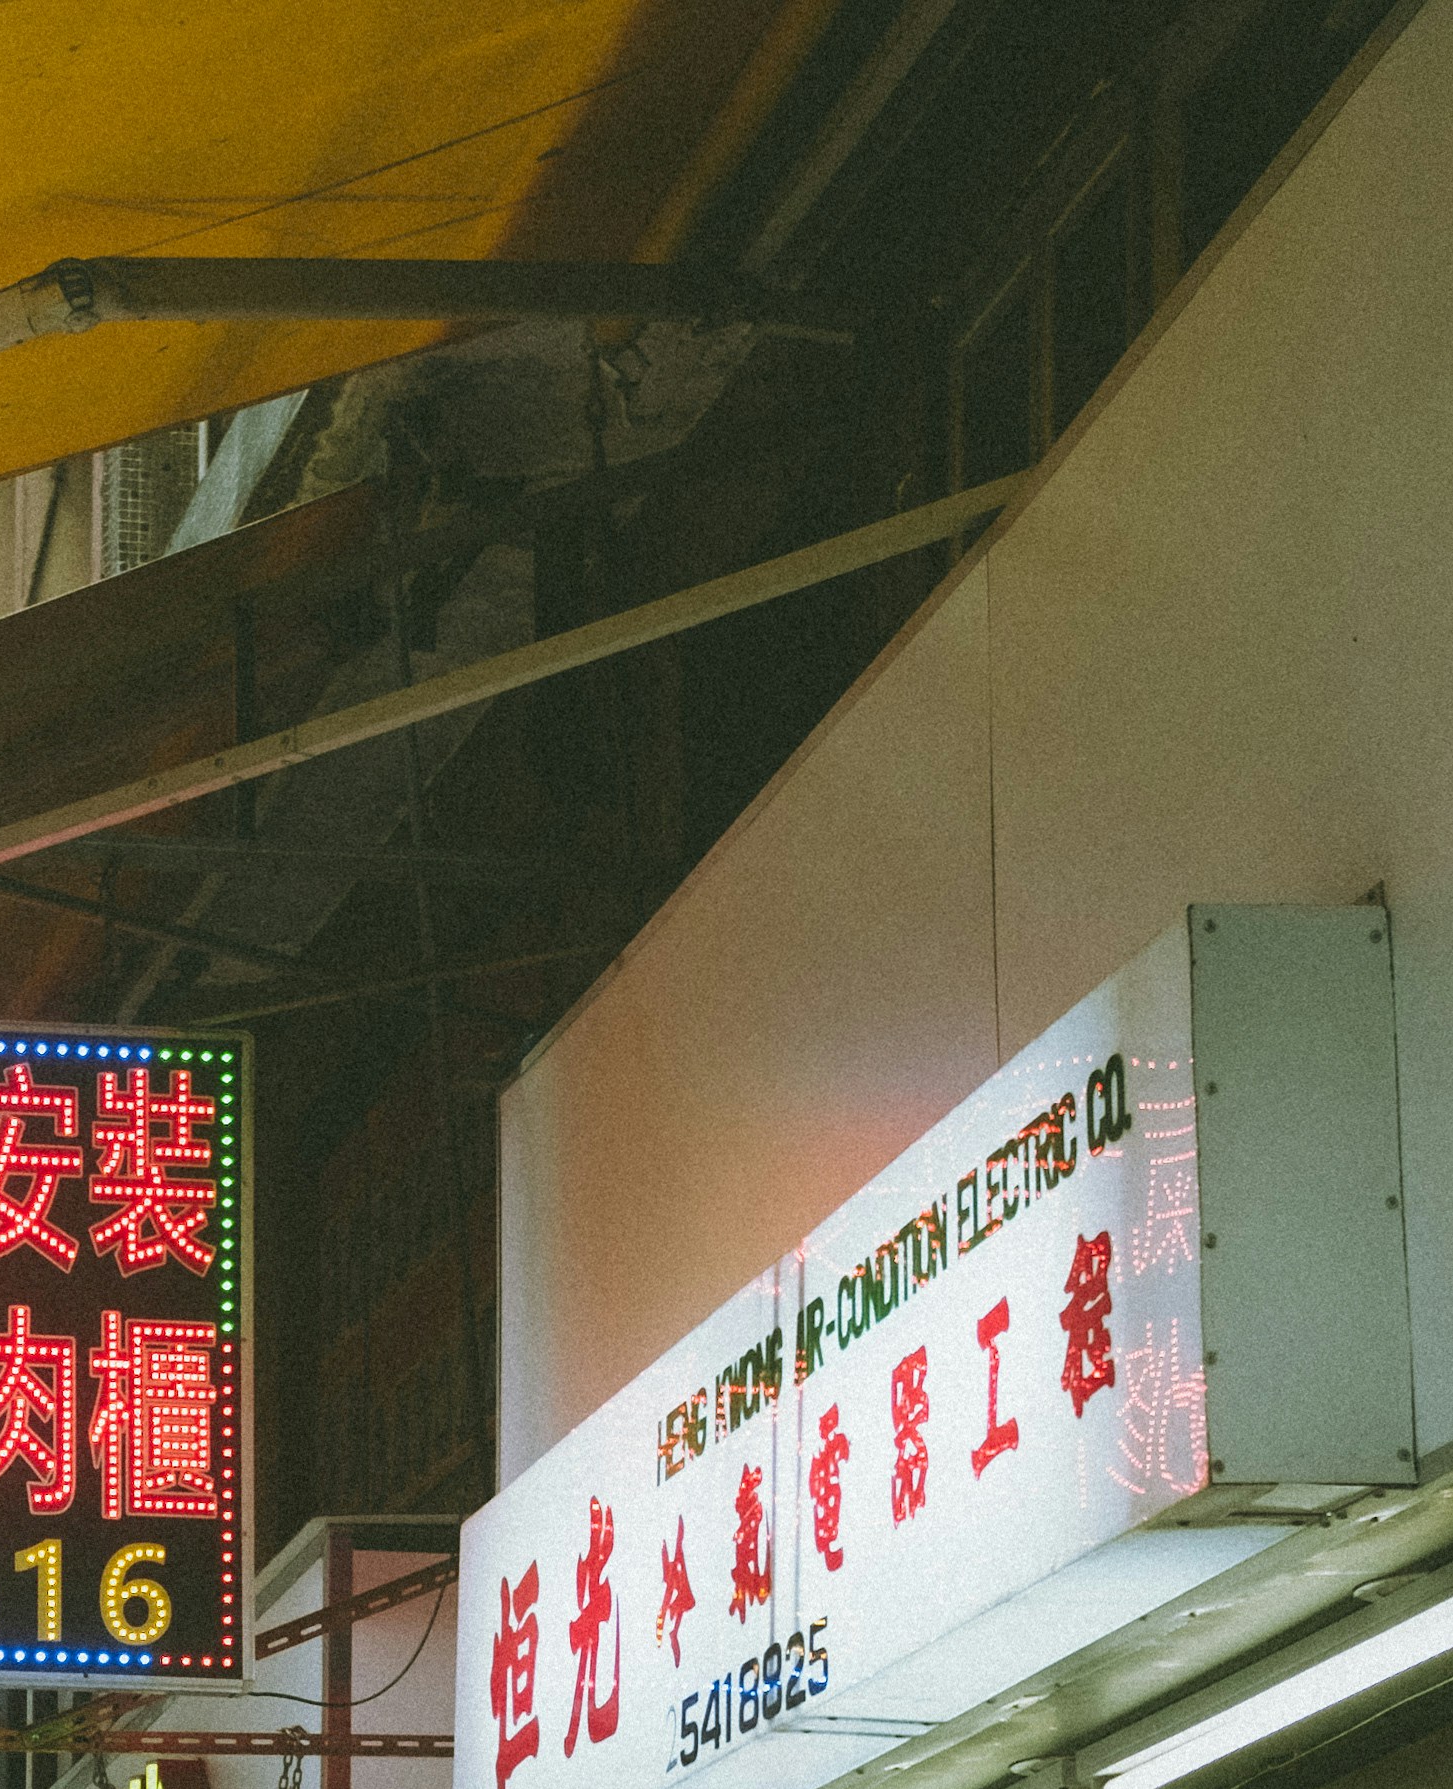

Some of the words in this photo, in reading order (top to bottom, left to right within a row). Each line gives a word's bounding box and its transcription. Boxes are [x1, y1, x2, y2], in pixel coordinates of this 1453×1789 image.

[657, 1387, 708, 1486] HENG
[714, 1327, 783, 1443] KWONG
[958, 1092, 1078, 1259] ELECTRIC
[1086, 1052, 1132, 1157] CO.
